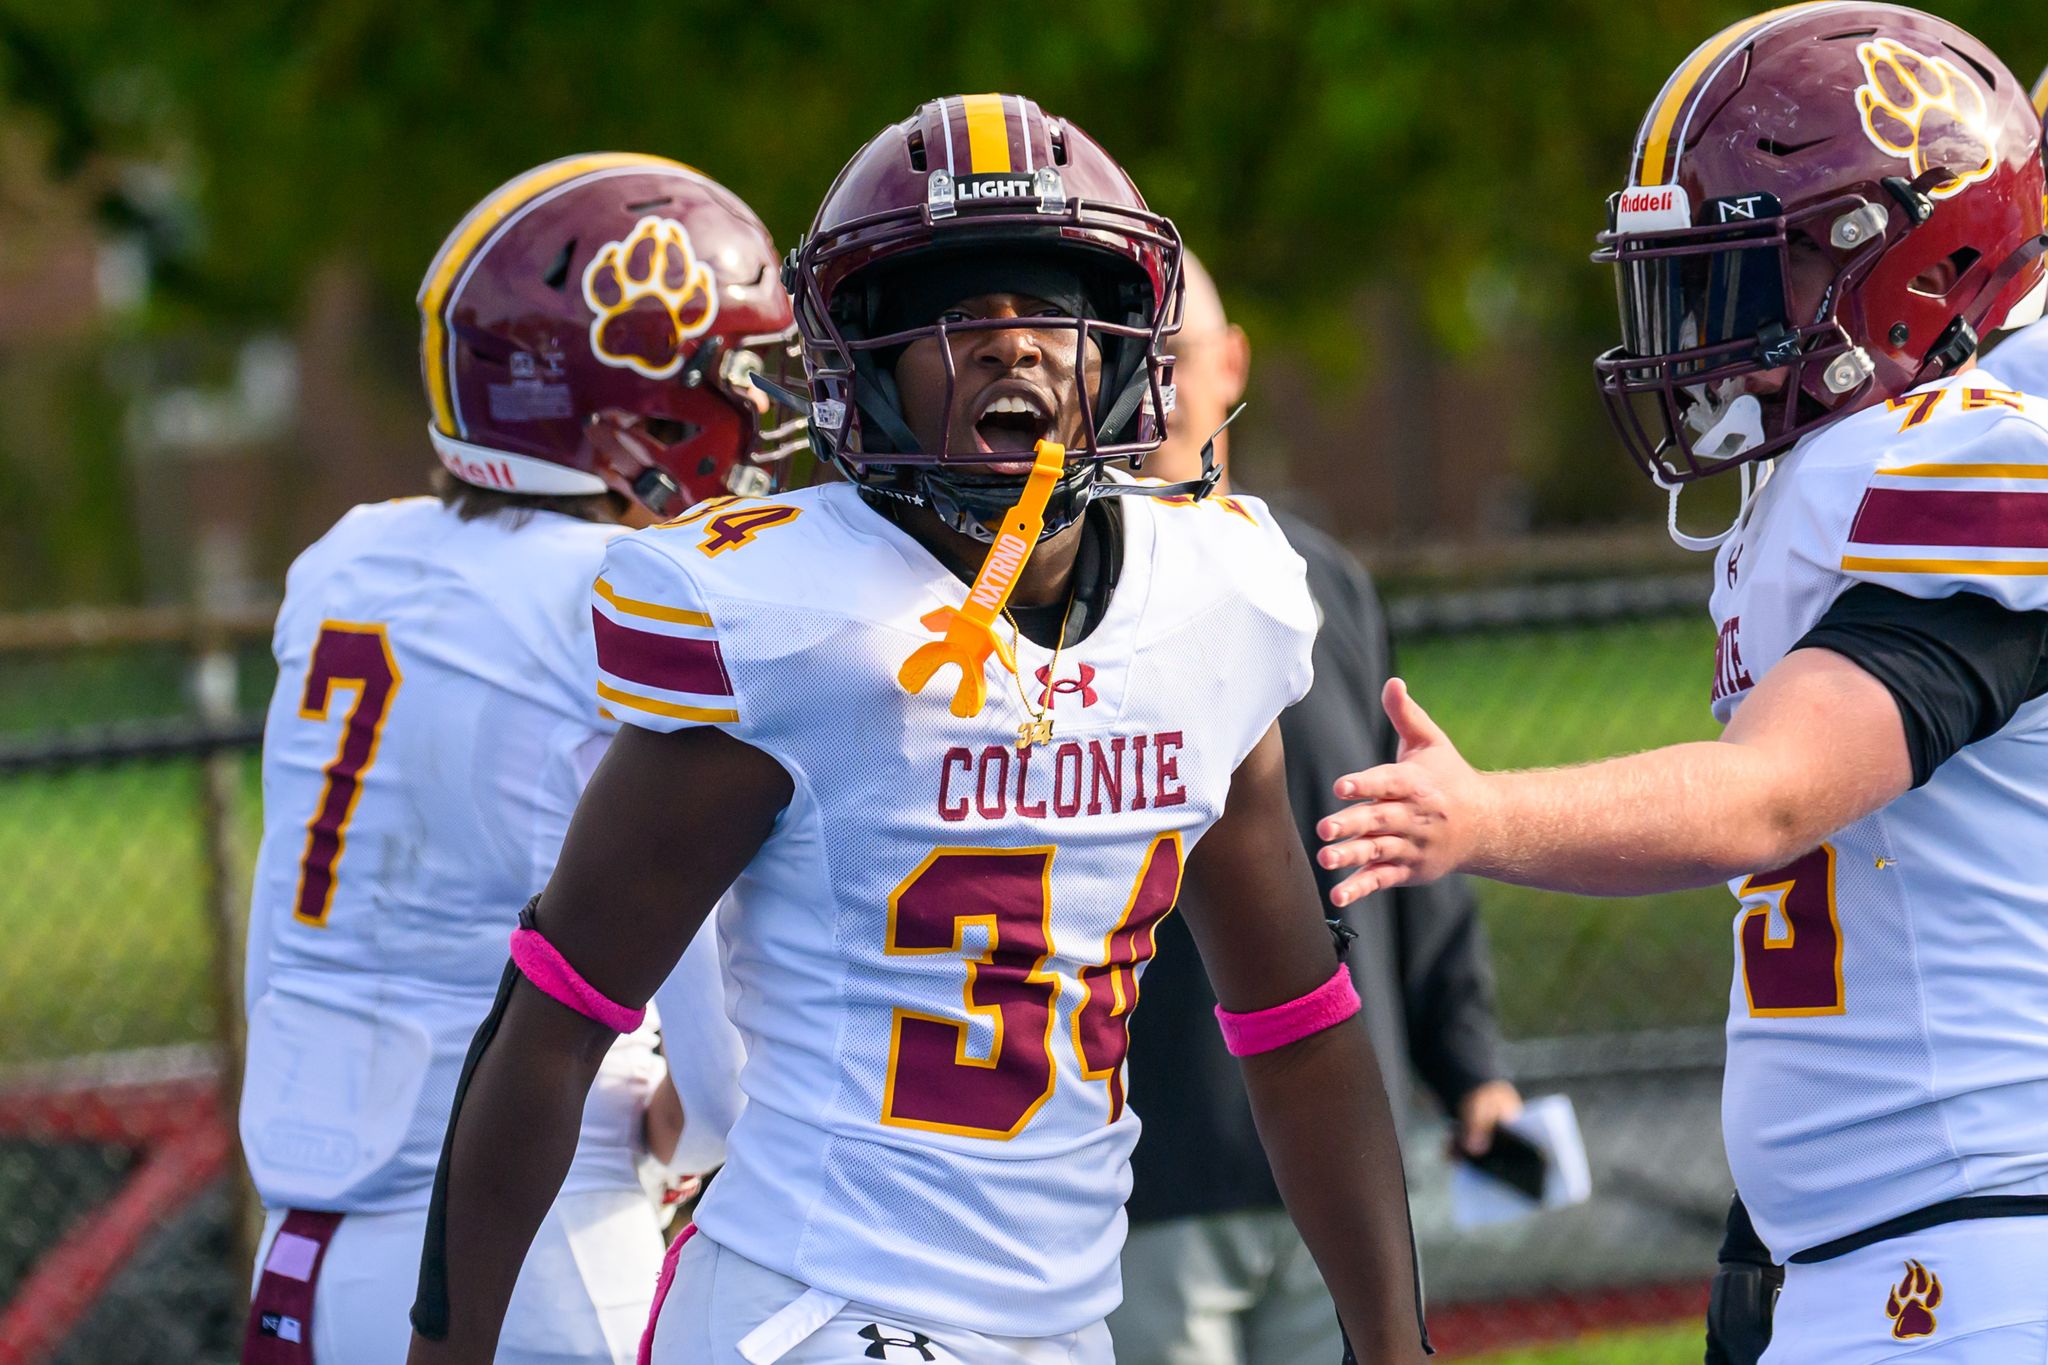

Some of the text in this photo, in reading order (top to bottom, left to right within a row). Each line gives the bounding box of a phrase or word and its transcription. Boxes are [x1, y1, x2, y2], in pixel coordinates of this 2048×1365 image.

[957, 179, 1030, 199] LIGHT
[1621, 191, 1673, 213] Riddell
[971, 533, 1027, 611] NXTRND
[293, 618, 404, 928] 7
[1015, 719, 1054, 750] 34
[938, 730, 1187, 822] COLONIE
[880, 830, 1184, 1142] 34
